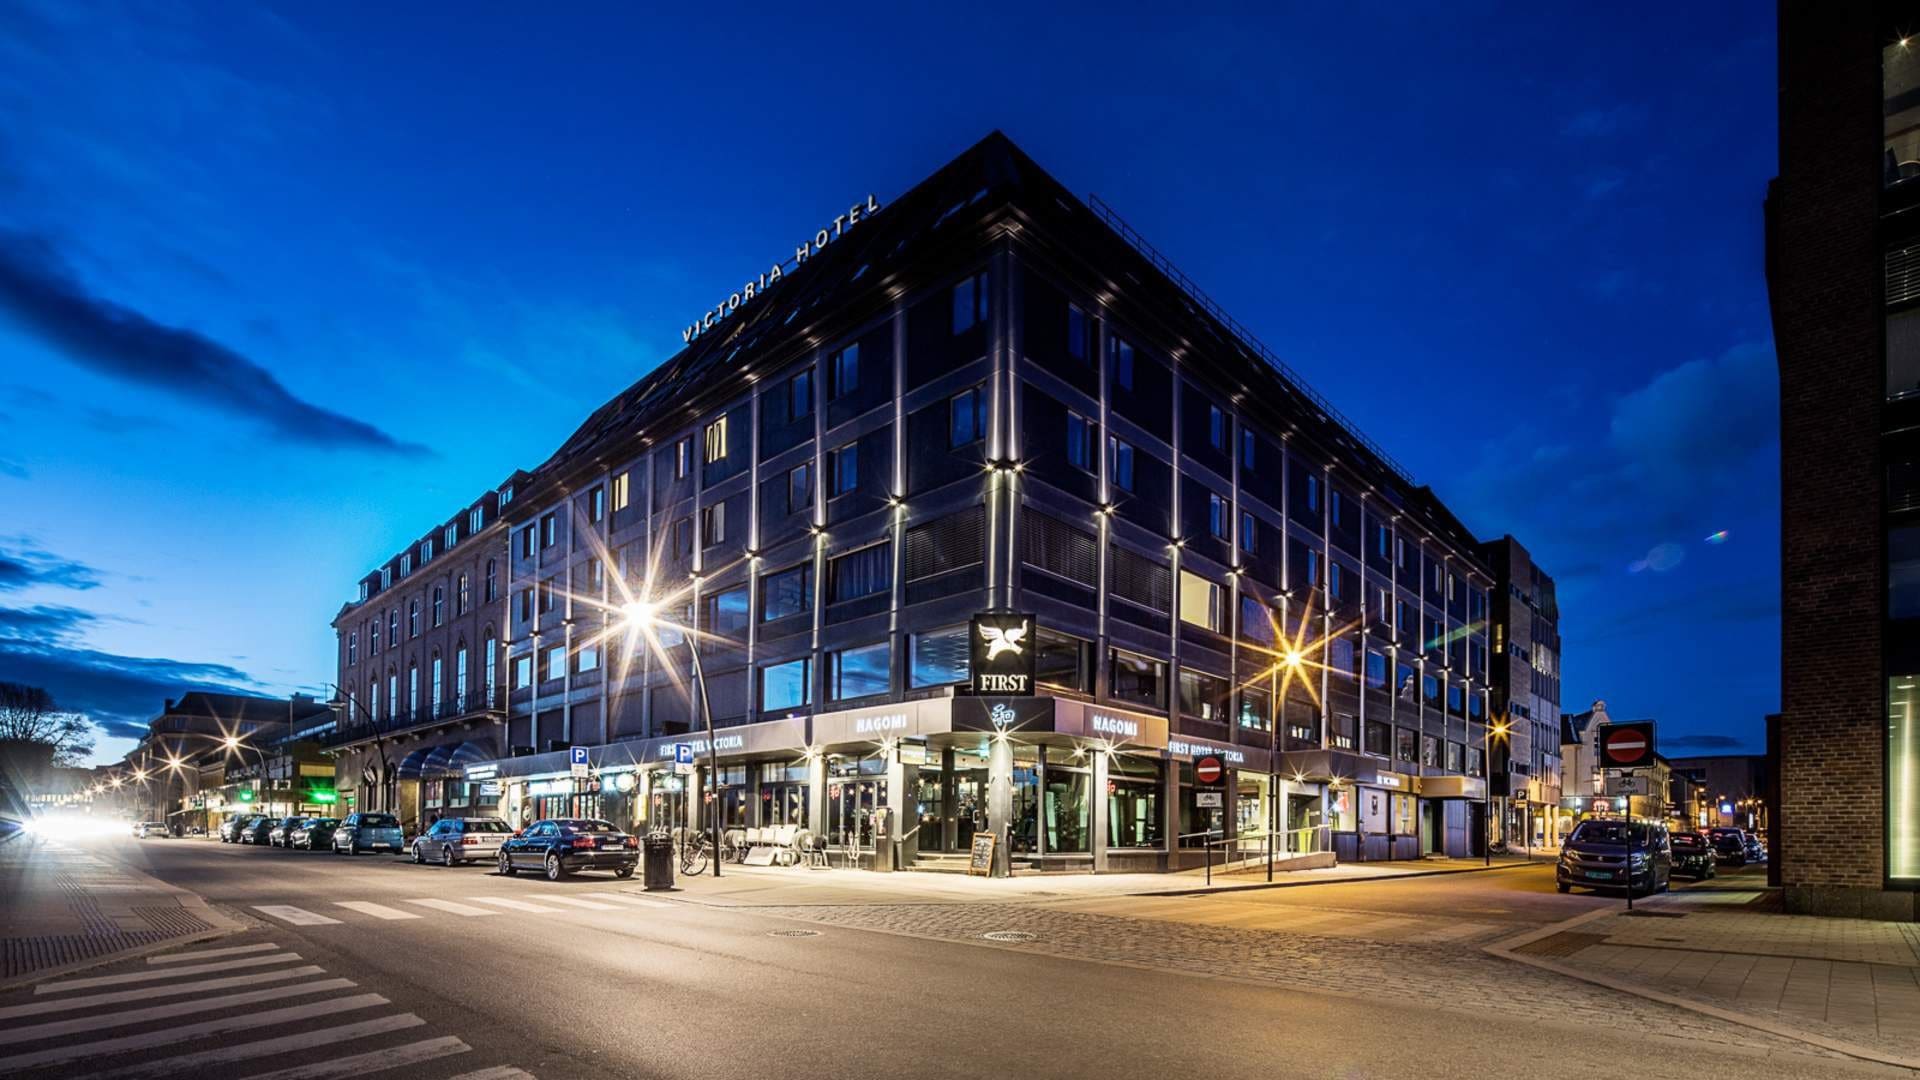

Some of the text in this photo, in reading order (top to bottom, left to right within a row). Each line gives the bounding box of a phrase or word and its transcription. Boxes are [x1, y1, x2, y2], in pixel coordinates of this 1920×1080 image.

[682, 193, 879, 342] VICTORIA HOTEL
[980, 674, 1028, 692] FIRST
[856, 714, 907, 733] NAGOMI
[1093, 715, 1138, 736] NAGOMI
[575, 750, 585, 762] P
[679, 746, 691, 762] P
[1168, 740, 1189, 755] FIRST
[1517, 791, 1525, 799] P
